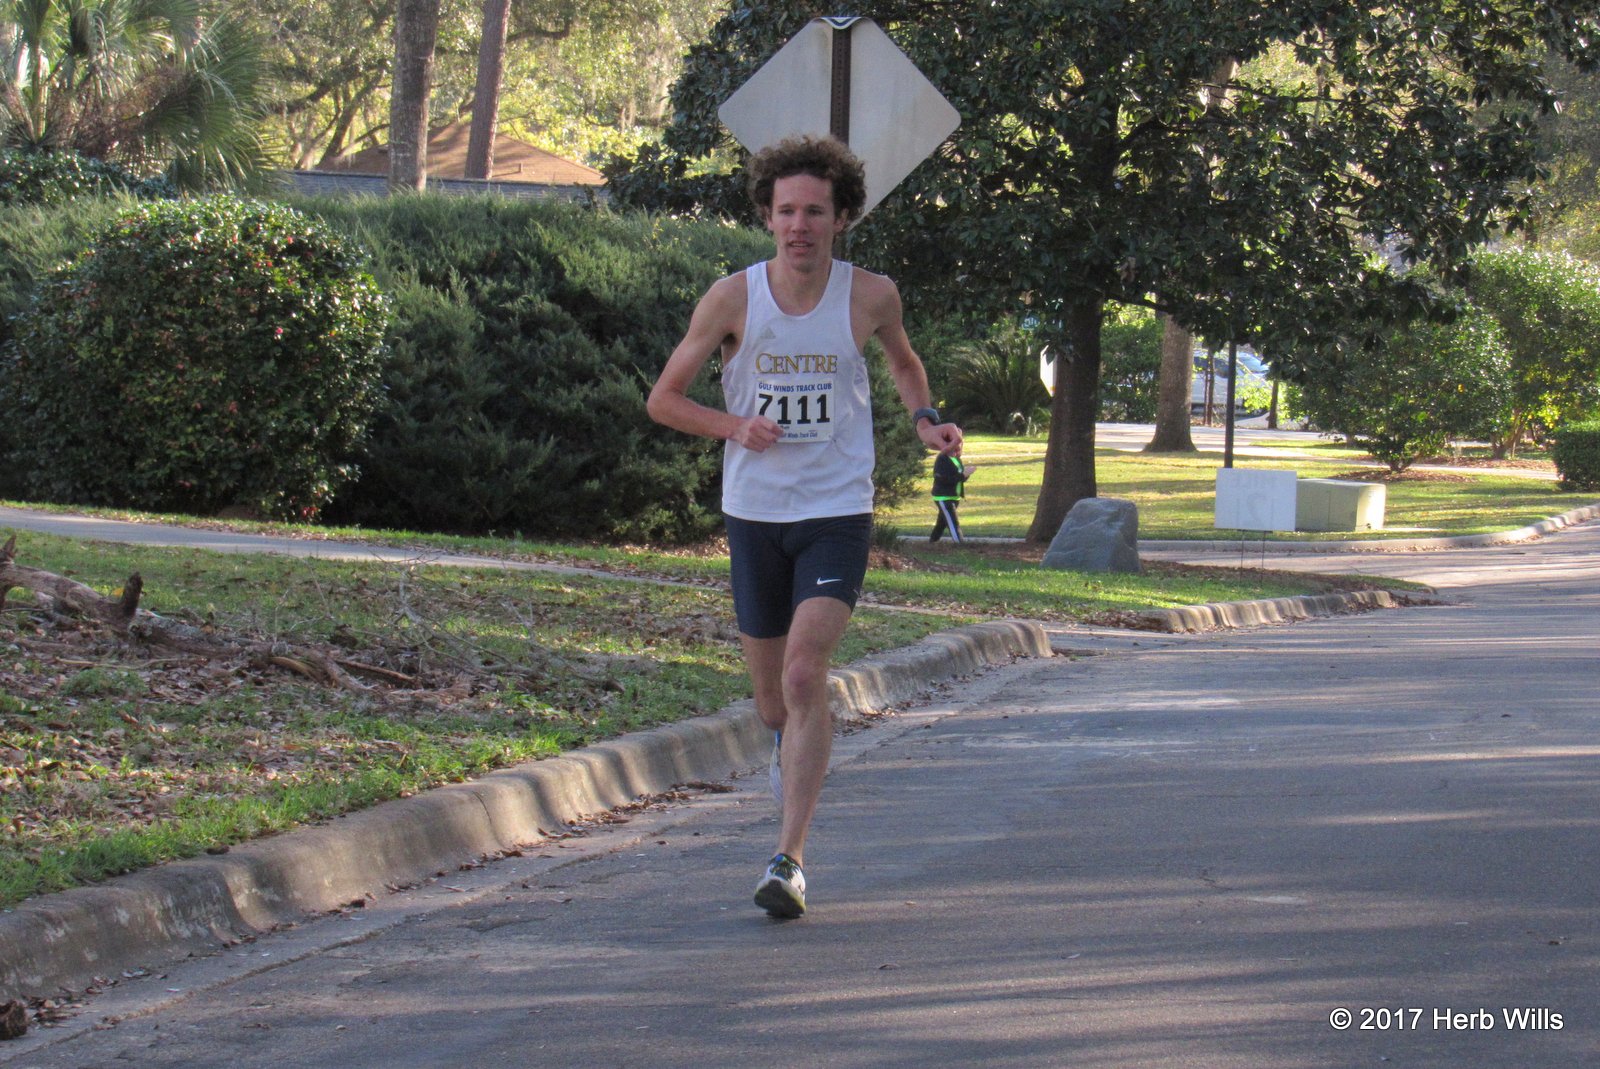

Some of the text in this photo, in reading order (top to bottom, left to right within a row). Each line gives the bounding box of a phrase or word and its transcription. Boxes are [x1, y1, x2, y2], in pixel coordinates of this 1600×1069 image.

[755, 353, 838, 374] CENTRE
[759, 382, 772, 391] GULF
[796, 384, 816, 392] TRACK
[817, 382, 832, 391] CLUB
[759, 393, 830, 424] 7111
